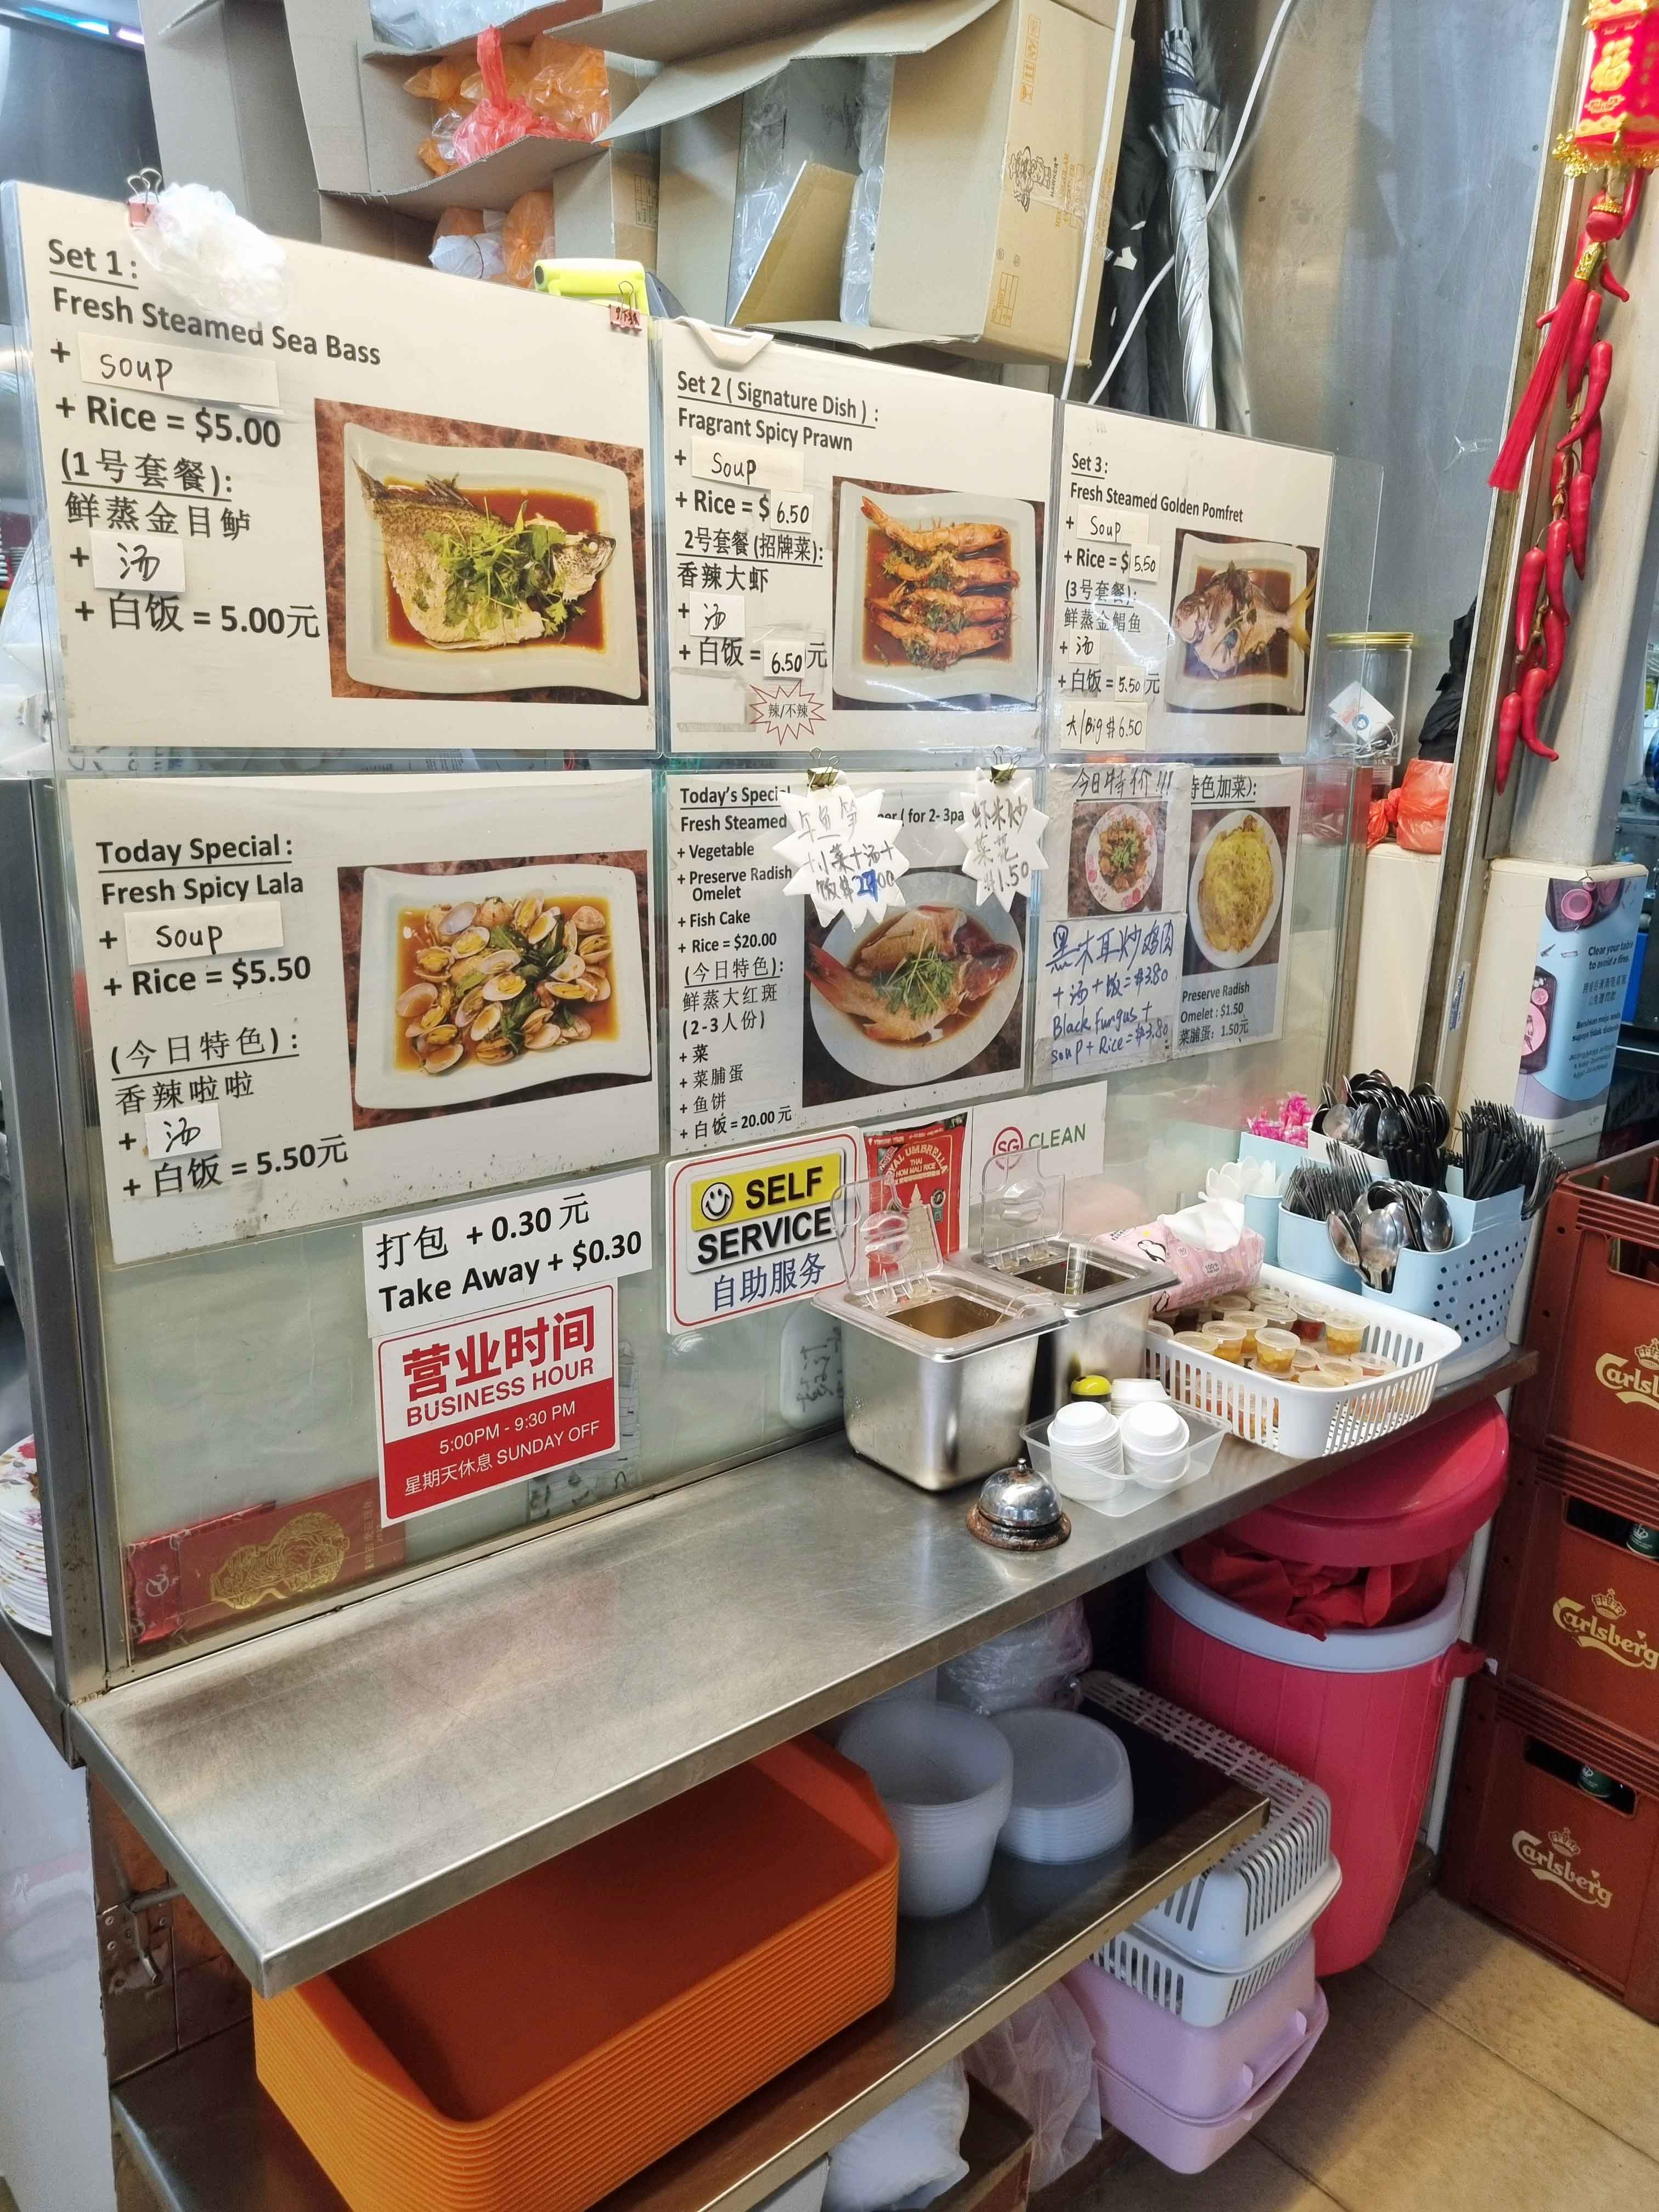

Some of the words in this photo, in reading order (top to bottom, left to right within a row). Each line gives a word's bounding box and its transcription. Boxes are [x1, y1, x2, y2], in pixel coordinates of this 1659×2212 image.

[48, 238, 97, 273] Set
[53, 287, 134, 324] Fresh
[142, 304, 263, 347] Steamed
[272, 325, 318, 356] Sea
[326, 332, 381, 366] Bass
[678, 370, 705, 393] Set
[711, 377, 721, 396] 2
[737, 381, 817, 413] Signature
[822, 394, 857, 420] Dish
[87, 395, 156, 431] Rice
[195, 407, 281, 448] $5.00
[678, 407, 751, 438] Fragrant
[756, 417, 798, 447] Spicy
[803, 427, 853, 451] Prawn
[1072, 452, 1091, 472] Set
[693, 489, 736, 515] Rice
[1071, 482, 1102, 504] Fresh
[1106, 488, 1157, 510] Steamed
[1160, 496, 1199, 516] Golden
[1203, 503, 1244, 523] Pomfret
[64, 493, 252, 542] 鲜蒸金目鲈
[118, 543, 160, 581] 汤
[1076, 548, 1105, 569] Rice
[678, 562, 769, 592] 香辣大虾
[109, 593, 184, 632] 白饭
[703, 603, 726, 631] 汤
[1064, 606, 1141, 634] 鲜蒸金鲳鱼
[699, 637, 744, 669] 白饭
[1076, 636, 1094, 656] 汤
[1071, 668, 1102, 694] 白饭
[768, 702, 809, 720] 辣/不辣
[680, 786, 738, 807] Today's
[741, 786, 790, 805] Speci
[680, 816, 721, 832] Fresh
[725, 814, 787, 831] Steamed
[909, 808, 926, 823] for
[943, 808, 964, 825] 3pa
[96, 839, 182, 867] Today
[689, 843, 754, 862] Vegetable
[101, 877, 176, 905] Fresh
[183, 874, 249, 904] Spicy
[257, 872, 303, 895] Lala
[690, 868, 746, 887] Preserve
[751, 866, 793, 881] Radish
[692, 885, 741, 901] Omelet
[690, 912, 716, 928] Fish
[719, 911, 751, 925] Cake
[692, 937, 719, 953] Rice
[734, 933, 777, 950] $20.00
[1589, 946, 1606, 956] Clear
[1606, 943, 1620, 955] your
[132, 968, 196, 996] Rice
[232, 955, 312, 989] $5.50
[1589, 961, 1596, 970] to
[1597, 957, 1613, 967] avoid
[683, 984, 777, 1012] 鲜蒸大红斑
[1182, 988, 1220, 1003] Preserve
[1223, 981, 1250, 996] Radish
[683, 1010, 765, 1039] (2-3人份)
[1053, 1005, 1091, 1041] Black
[1181, 1007, 1213, 1023] Omelet
[1221, 1002, 1243, 1018] $1.50
[1099, 1036, 1124, 1054] Rice
[1136, 1018, 1168, 1047] $3.80
[692, 1043, 708, 1063] 菜
[692, 1063, 744, 1087] 菜脯蛋
[115, 1070, 255, 1116] 香辣啦啦
[693, 1093, 726, 1114] 鱼饼
[164, 1117, 201, 1152] 汤
[694, 1115, 727, 1138] 白饭
[1029, 1124, 1086, 1149] CLEAN
[896, 1169, 909, 1178] HOM
[910, 1165, 922, 1174] MALI
[923, 1162, 936, 1171] RICE
[905, 1143, 949, 1173] UMBRELLA
[910, 1158, 923, 1166] THAI
[154, 1154, 224, 1198] 白饭
[746, 1166, 823, 1209] SELF
[376, 1224, 449, 1270] 打包
[698, 1205, 833, 1266] SERVICE
[379, 1278, 452, 1313] Take
[462, 1258, 540, 1295] Away
[572, 1231, 642, 1272] $0.30
[714, 1252, 826, 1313] 自助服务
[403, 1305, 595, 1402] 营业时间
[1595, 1352, 1659, 1397] Carls
[407, 1377, 525, 1426] BUSINESS
[533, 1358, 594, 1389] HOUR
[439, 1423, 499, 1455] 5:00PM
[515, 1409, 547, 1432] 9:30
[552, 1401, 576, 1423] PM
[404, 1453, 494, 1496] 星期天休息
[496, 1429, 565, 1466] SUNDAY
[568, 1420, 600, 1443] OFF
[1553, 1597, 1659, 1669] Carlsberg
[1512, 1830, 1613, 1908] Carlsberg
